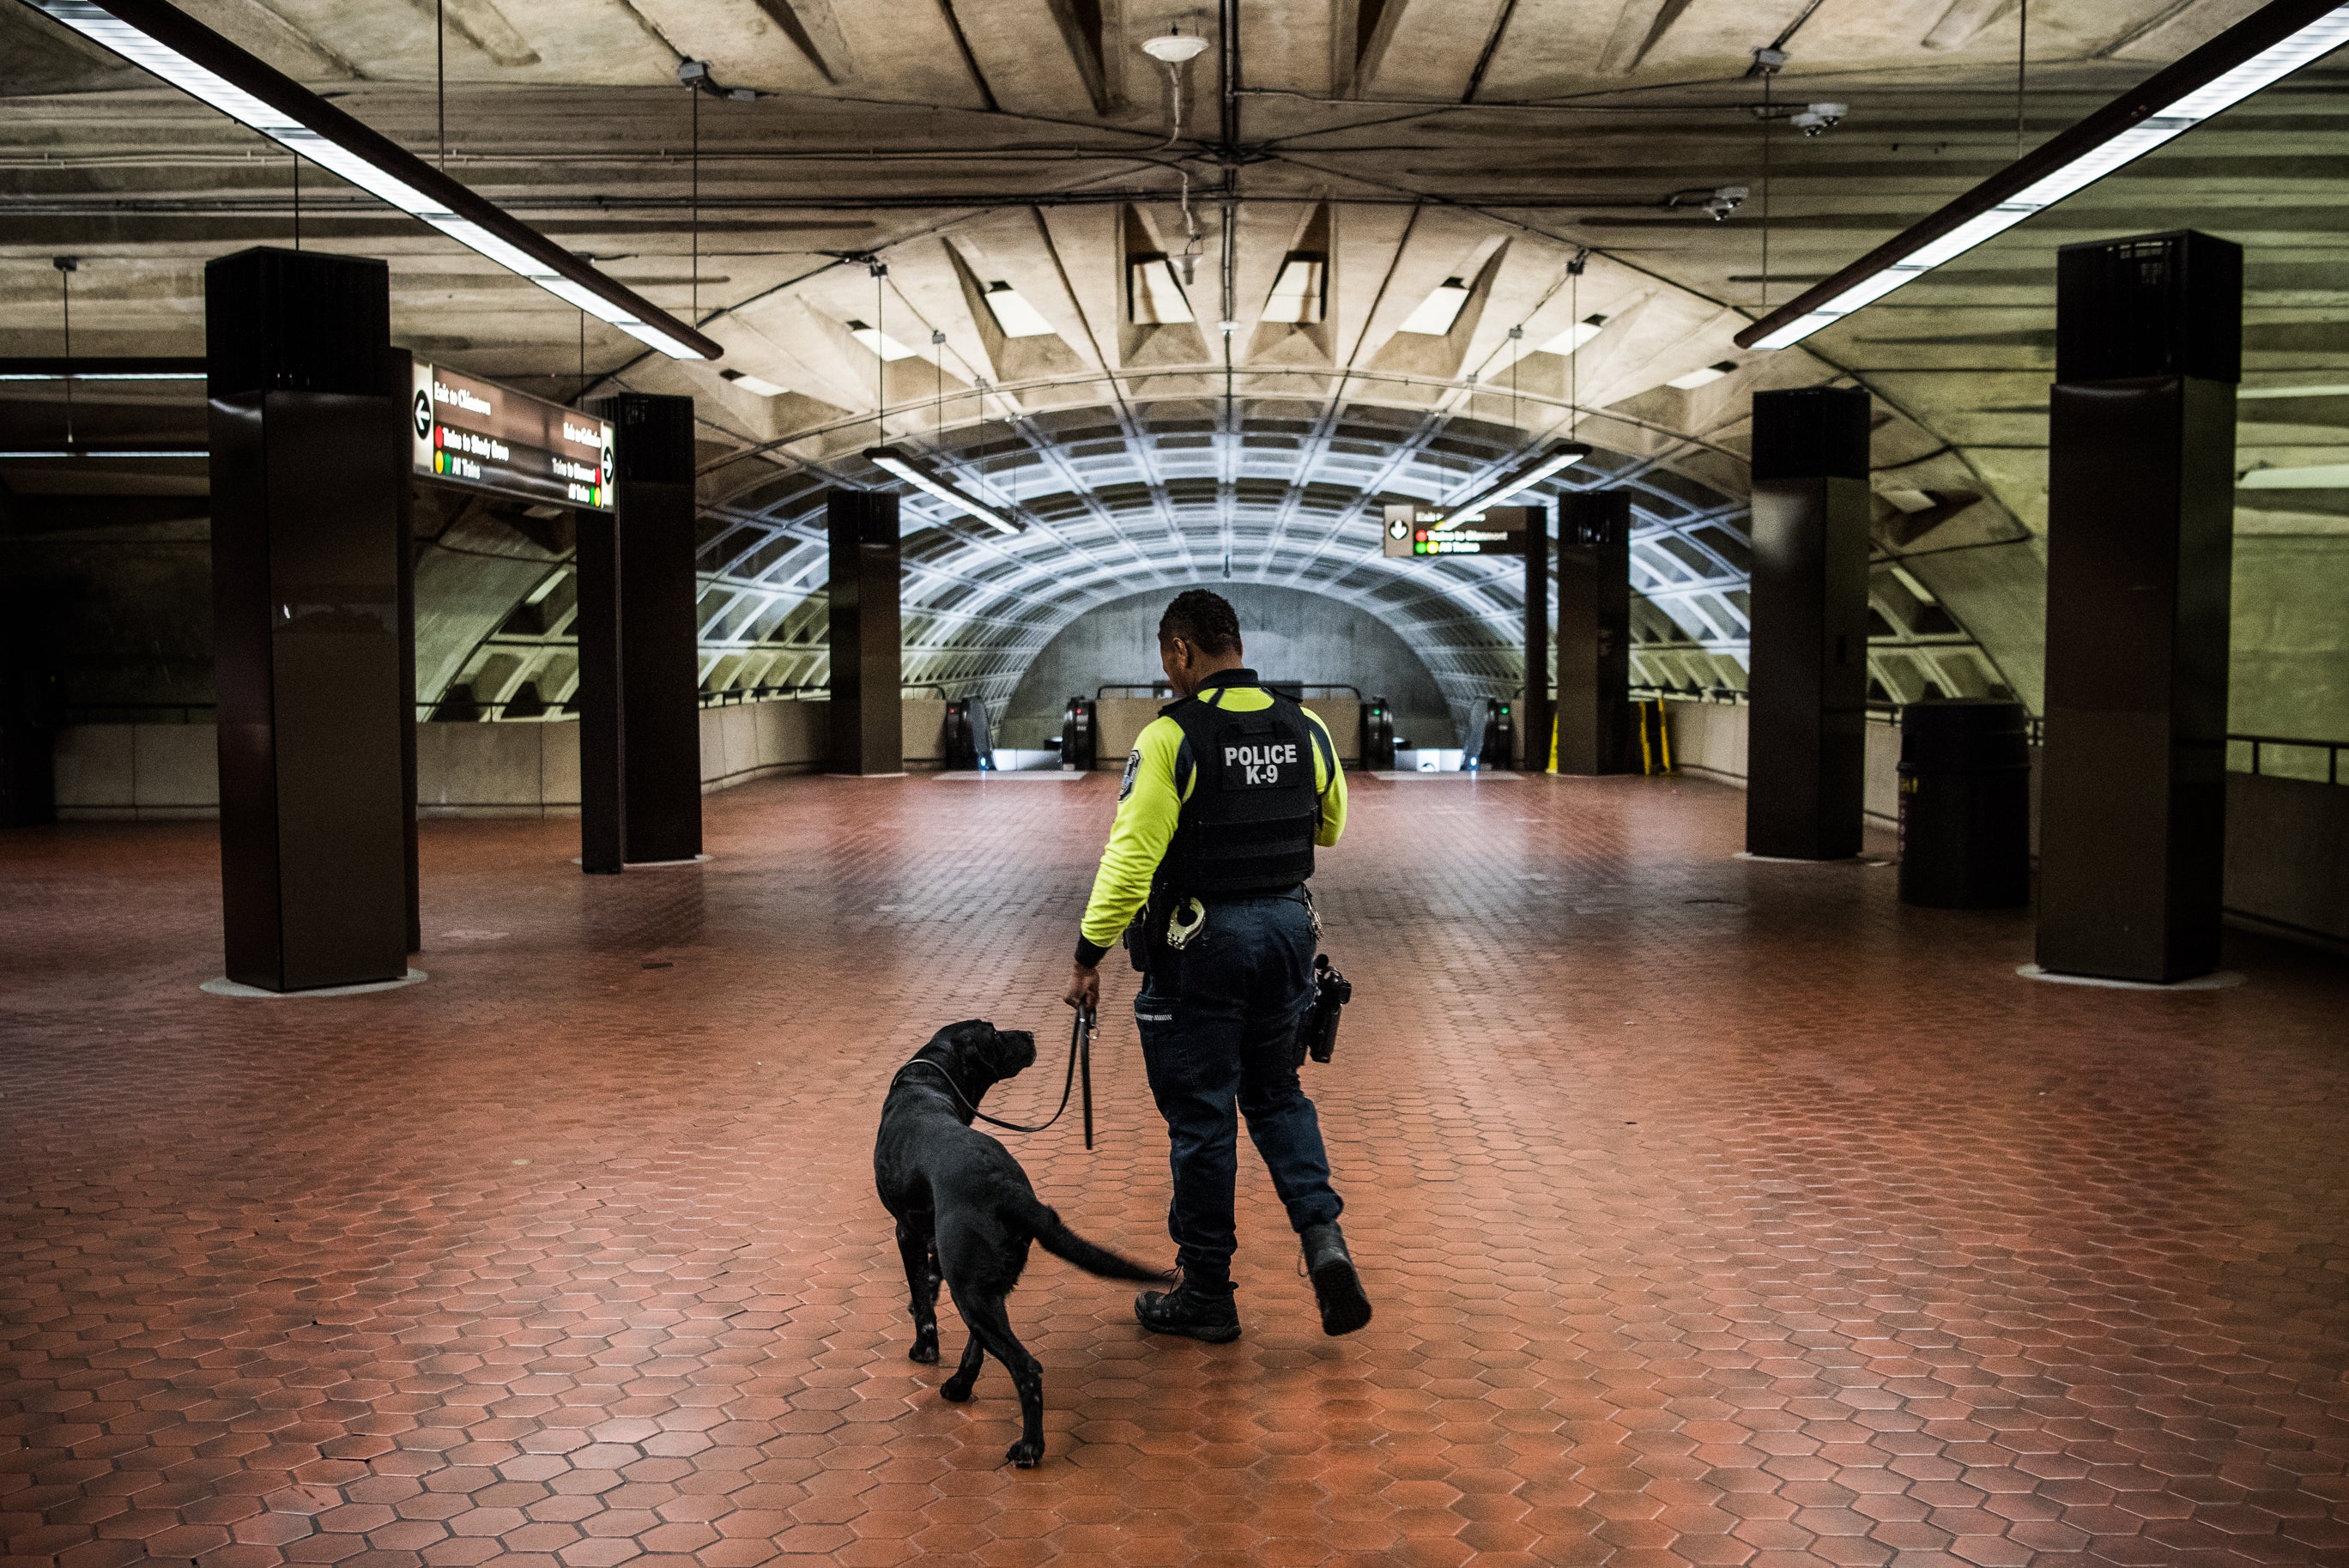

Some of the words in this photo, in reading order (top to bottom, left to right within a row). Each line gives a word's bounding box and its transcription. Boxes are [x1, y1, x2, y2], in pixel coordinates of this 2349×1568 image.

[442, 427, 462, 451] Trains
[463, 433, 471, 452] to
[451, 457, 462, 475] All
[462, 458, 481, 480] Trains
[1225, 744, 1297, 766] POLICE
[1245, 764, 1278, 785] K-9
